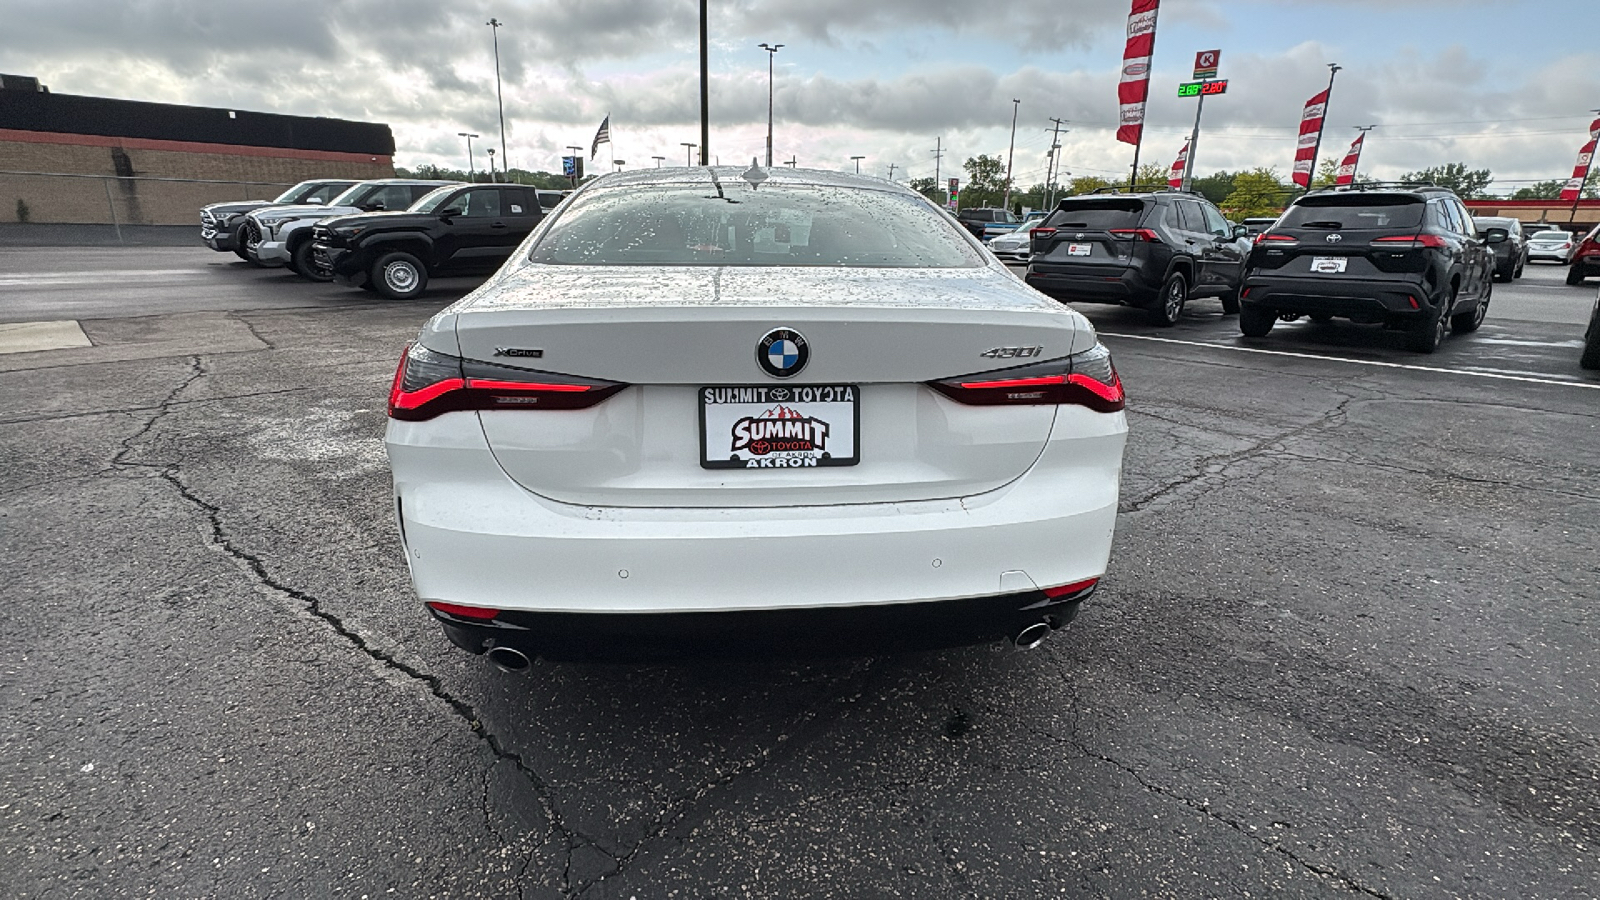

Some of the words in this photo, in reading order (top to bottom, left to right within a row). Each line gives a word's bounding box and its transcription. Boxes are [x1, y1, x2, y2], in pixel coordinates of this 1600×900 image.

[1202, 54, 1213, 65] K
[705, 388, 768, 403] SUMMIT
[793, 387, 854, 402] TOYOTA
[734, 419, 827, 449] SUMMIT
[771, 442, 812, 450] TOYOTA
[746, 458, 817, 468] AKRON
